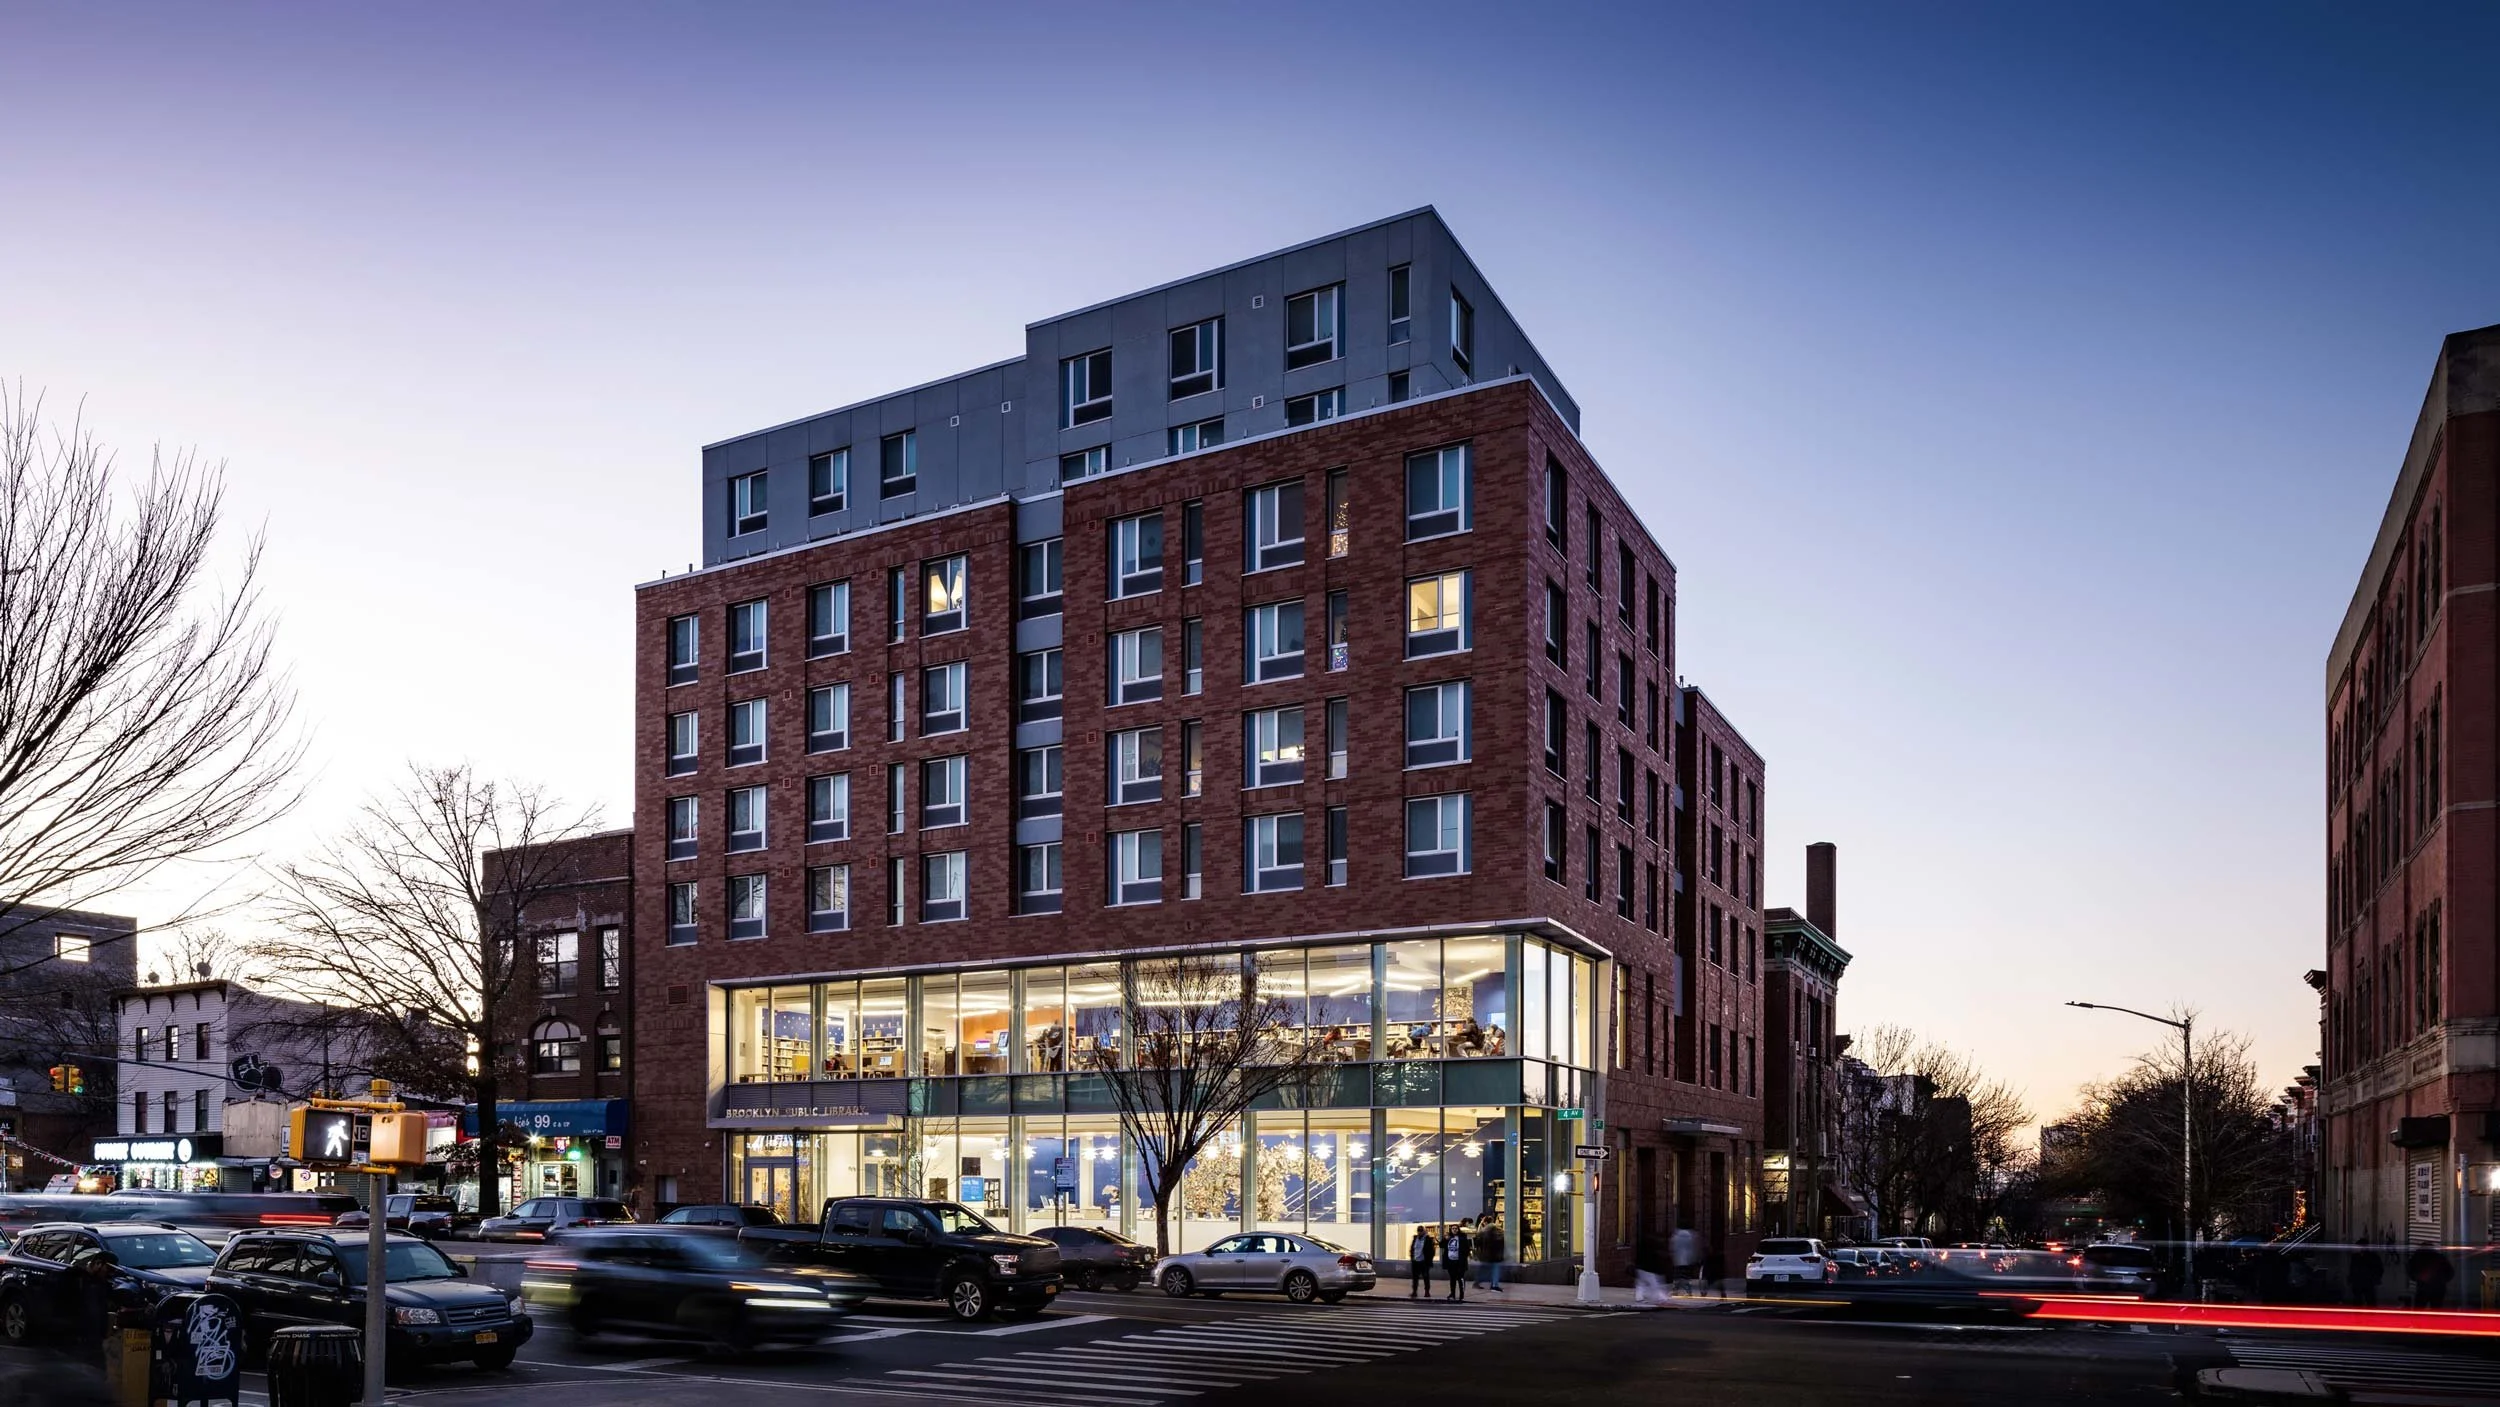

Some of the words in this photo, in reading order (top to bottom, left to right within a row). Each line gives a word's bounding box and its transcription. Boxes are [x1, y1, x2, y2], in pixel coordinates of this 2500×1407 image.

[726, 1109, 779, 1118] BROOKLYN
[786, 1107, 818, 1118] PUBLIC
[824, 1106, 867, 1117] LIBRARY
[1563, 1110, 1568, 1118] 4
[534, 1114, 551, 1129] 99
[607, 1136, 620, 1145] ATM
